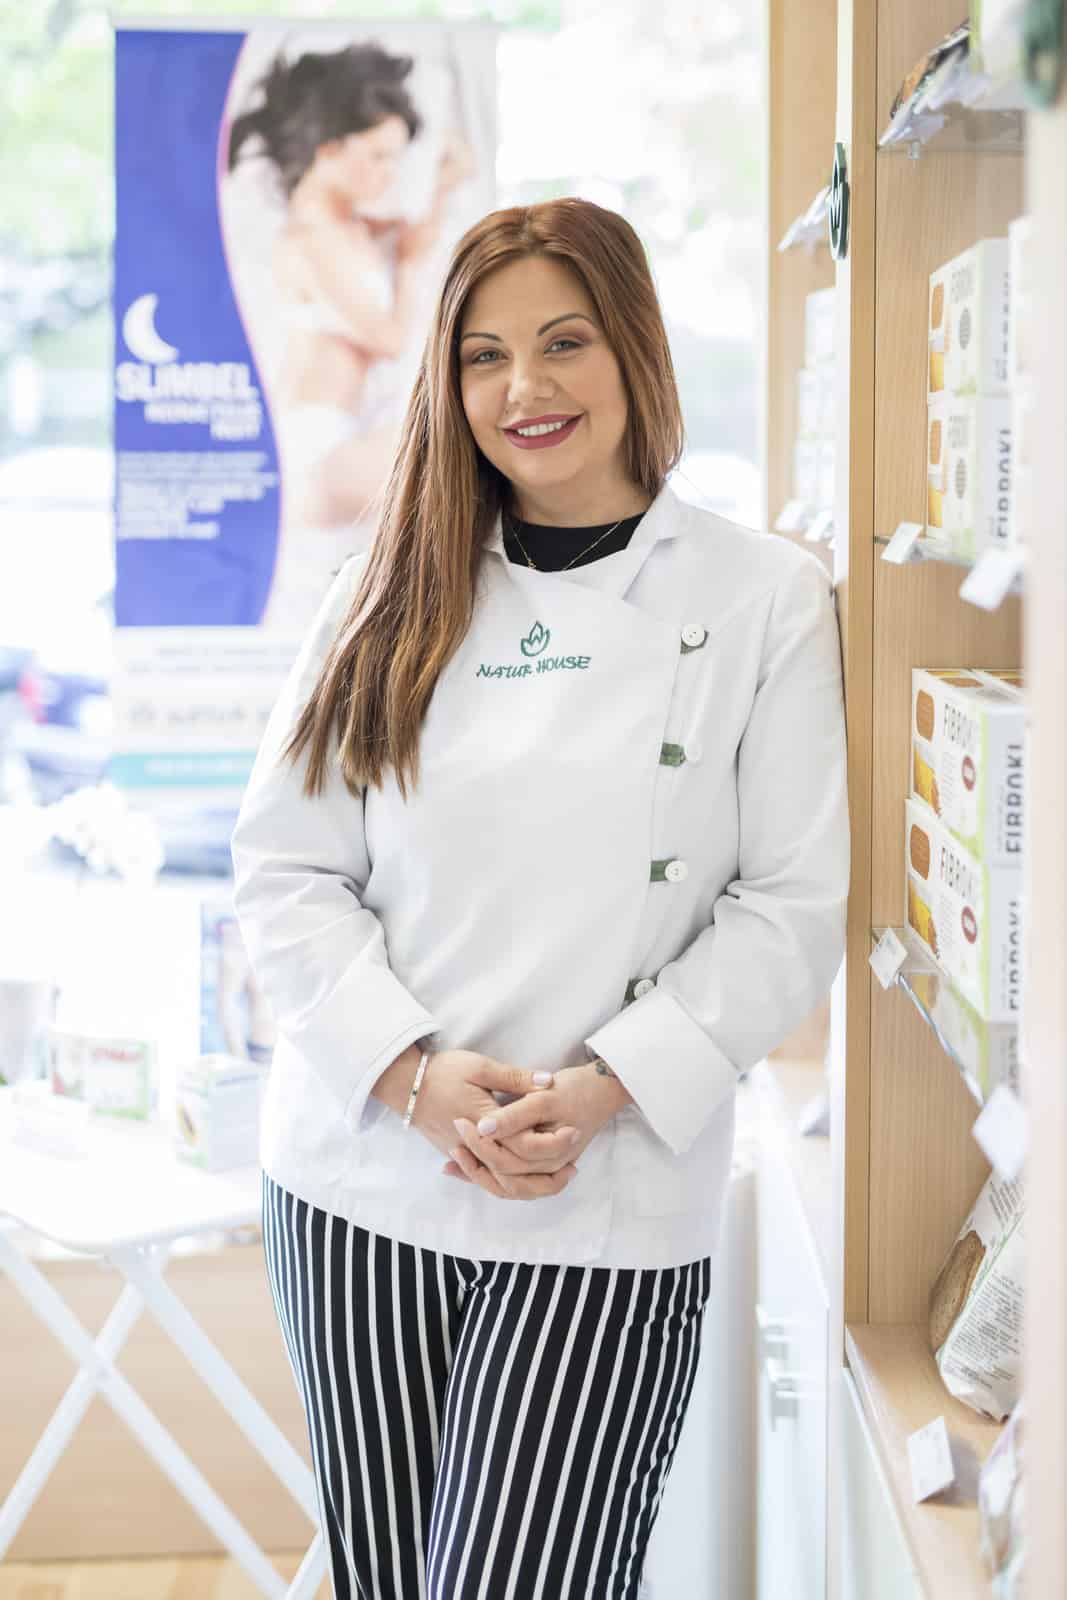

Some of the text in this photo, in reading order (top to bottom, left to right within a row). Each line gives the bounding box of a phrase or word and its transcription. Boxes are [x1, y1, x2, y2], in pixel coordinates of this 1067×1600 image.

[476, 655, 592, 679] NATUR HOUSE
[1005, 744, 1022, 854] FIBROKI
